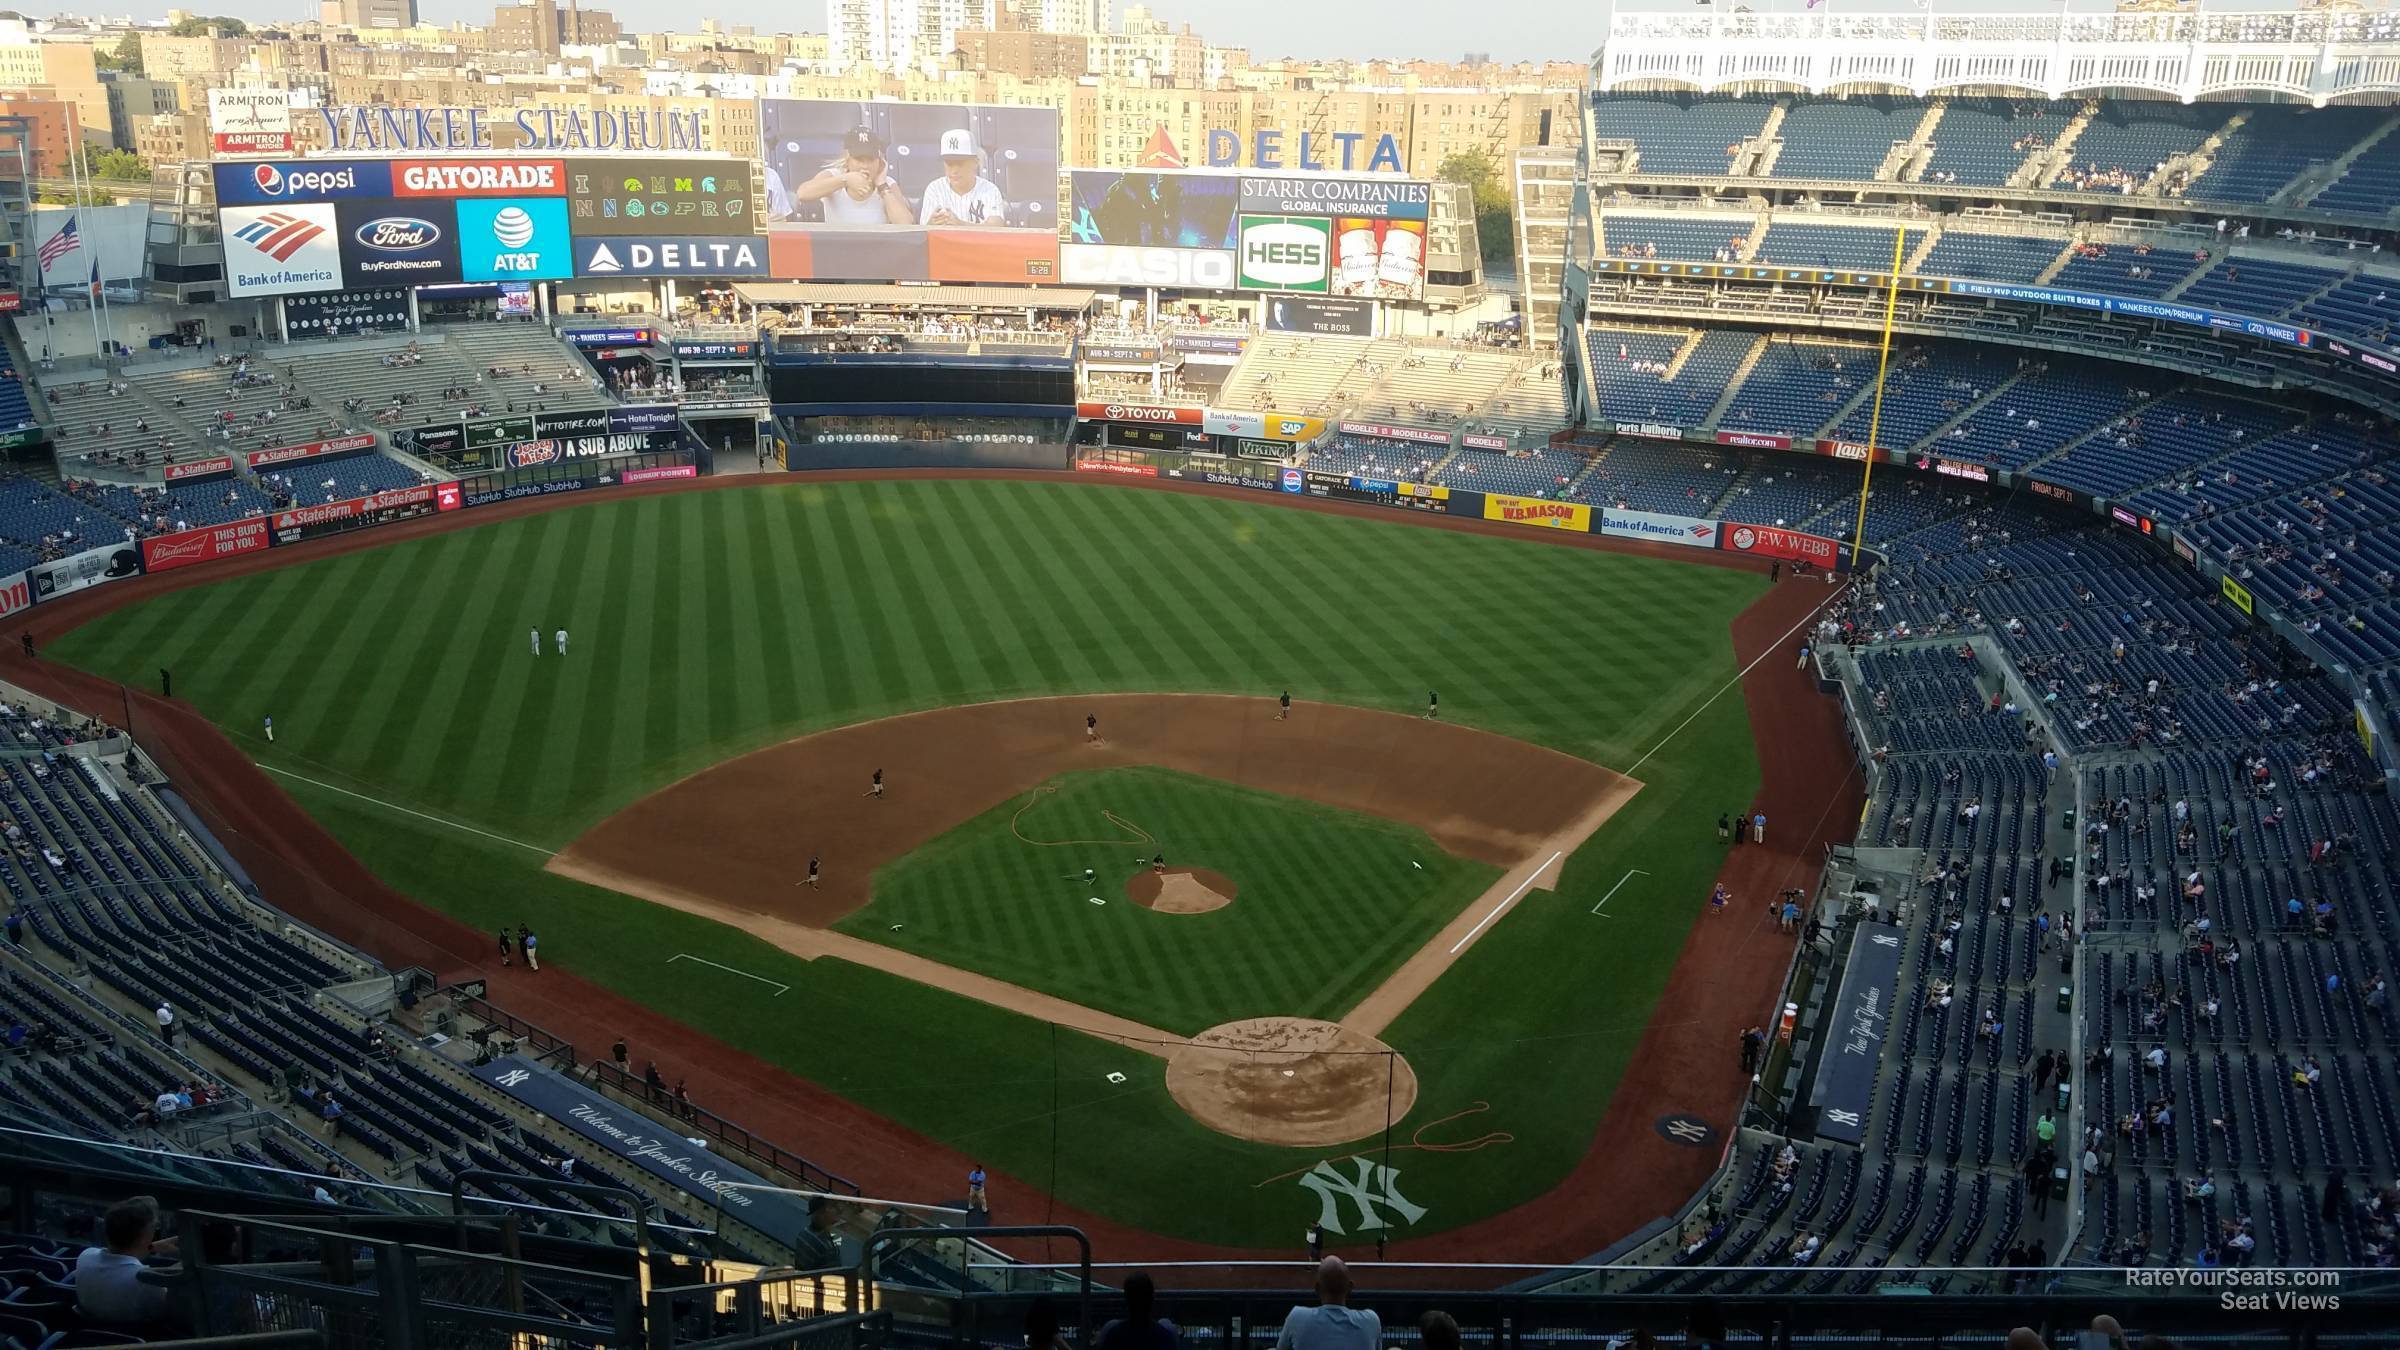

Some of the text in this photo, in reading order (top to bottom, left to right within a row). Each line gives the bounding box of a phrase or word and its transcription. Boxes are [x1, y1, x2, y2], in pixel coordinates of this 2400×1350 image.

[218, 95, 283, 106] ARMITRON
[319, 107, 702, 152] YANKEE STADIUM
[227, 134, 285, 144] ARMITRON
[1208, 128, 1404, 173] DELTA
[288, 167, 354, 195] pepsi
[404, 165, 554, 190] GATORADE
[1243, 178, 1308, 199] STARR
[1311, 182, 1428, 204] COMPANIES
[1281, 200, 1388, 215] GLOBAL INSURANCE
[373, 221, 424, 246] Ford
[494, 253, 540, 272] AT&T
[631, 243, 757, 268] DELTA
[1248, 241, 1320, 266] HESS
[361, 260, 441, 272] BuyFordNow.com
[1068, 247, 1232, 287] CASIO
[238, 269, 333, 287] Bank of America
[1970, 285, 1992, 294] FIELD
[1994, 287, 2011, 296] MVP
[2012, 289, 2051, 301] OUTDOOR
[2052, 294, 2075, 304] SUITE
[2076, 296, 2101, 306] BOXES
[2118, 301, 2203, 322] YANKEES.COM/PREMIUM
[2265, 326, 2295, 341] YANKEES
[1313, 323, 1351, 332] THE BOSS
[580, 333, 606, 342] YANKEES
[679, 346, 692, 355] AUG
[705, 345, 721, 354] SEPT
[1089, 350, 1102, 358] AUG
[1127, 407, 1177, 421] TOYOTA
[1209, 412, 1226, 421] Bank
[1232, 413, 1258, 423] America
[420, 428, 459, 440] Panasonic
[1280, 422, 1301, 435] SAP
[1343, 423, 1446, 442] MODELL'S MODELLS.com
[1615, 422, 1639, 433] Parts
[1639, 423, 1683, 437] Authority
[515, 439, 554, 455] Jersey
[566, 433, 650, 458] A SUB ABOVE
[1240, 440, 1287, 459] VIKING
[1729, 435, 1776, 448] realtor.com
[660, 469, 691, 477] DONUTS
[1937, 465, 1962, 476] FAIRFIELD
[1206, 473, 1274, 490] StubHub StubHub
[1369, 481, 1389, 490] pepsi
[467, 480, 581, 506] StubHub StubHub StubHub
[2053, 487, 2066, 499] SEPT
[214, 522, 266, 541] THIS BUD'S
[1603, 517, 1685, 537] Bank of America
[152, 543, 204, 560] Budweiser
[215, 538, 258, 554] FOR YOU.
[1757, 530, 1784, 548] F.W.
[1787, 535, 1830, 557] WEBB
[1845, 986, 1885, 1055] New York Yankees
[495, 1069, 530, 1087] NY
[568, 1103, 752, 1207] Welcome to Yankee Stadium
[1298, 1155, 1429, 1236] NY
